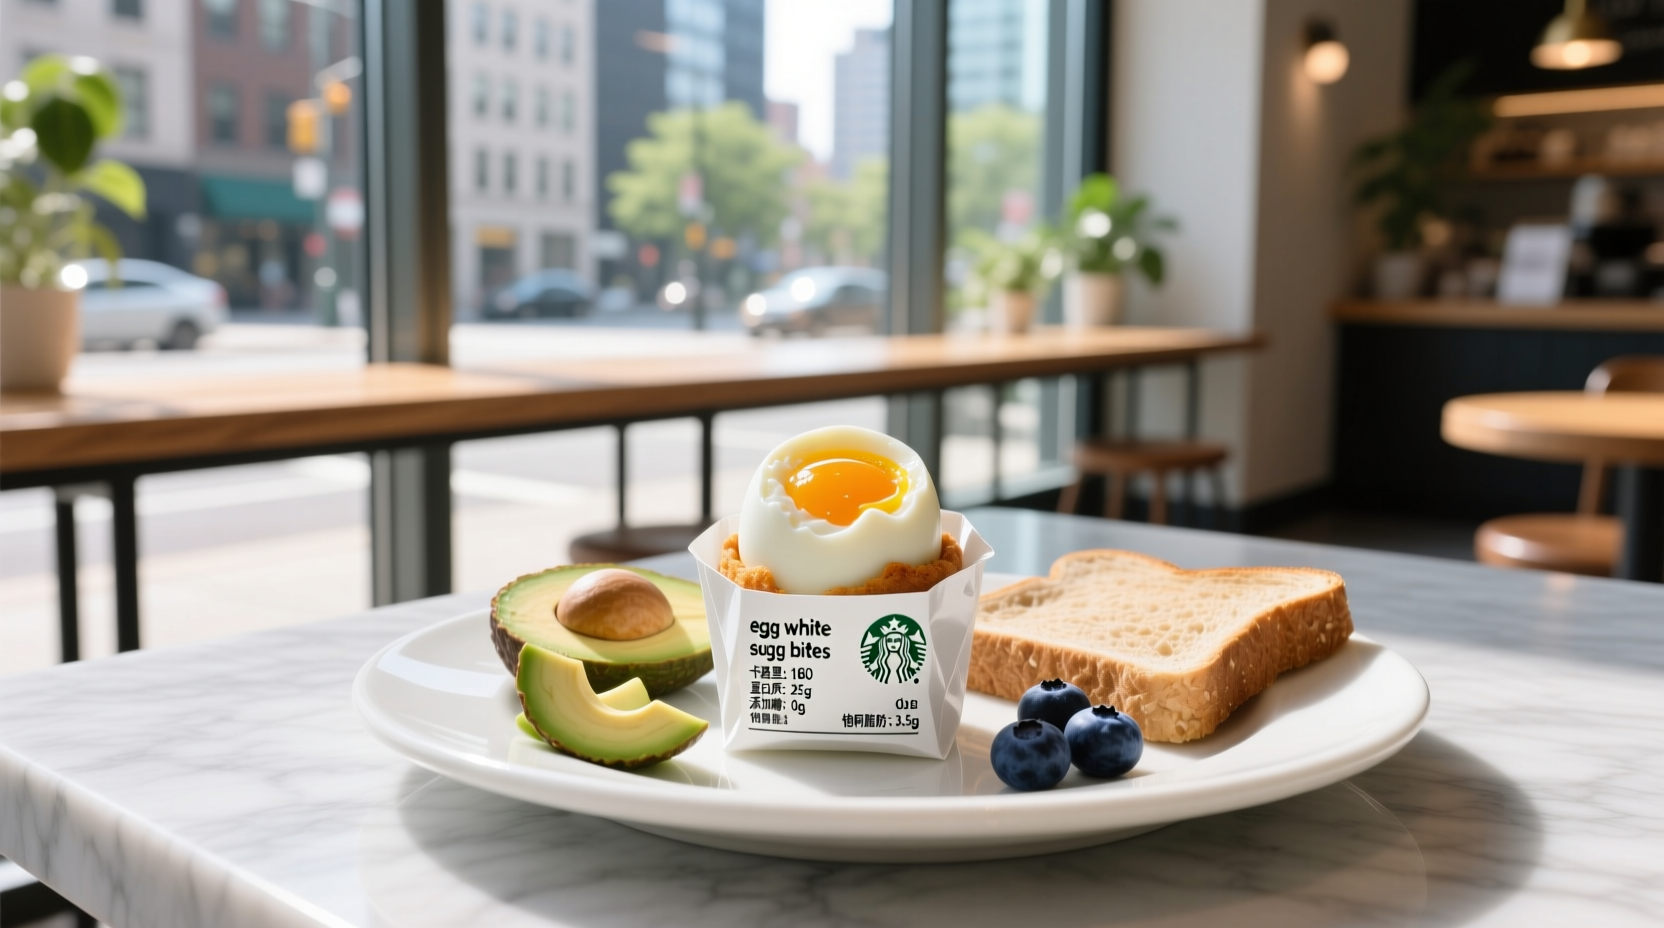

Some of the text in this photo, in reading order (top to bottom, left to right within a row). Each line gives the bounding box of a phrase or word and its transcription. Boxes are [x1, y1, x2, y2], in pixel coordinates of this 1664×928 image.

[750, 618, 832, 639] egg white
[750, 641, 831, 662] sugg bites
[790, 684, 812, 699] 25g
[895, 714, 919, 730] 3.5g
